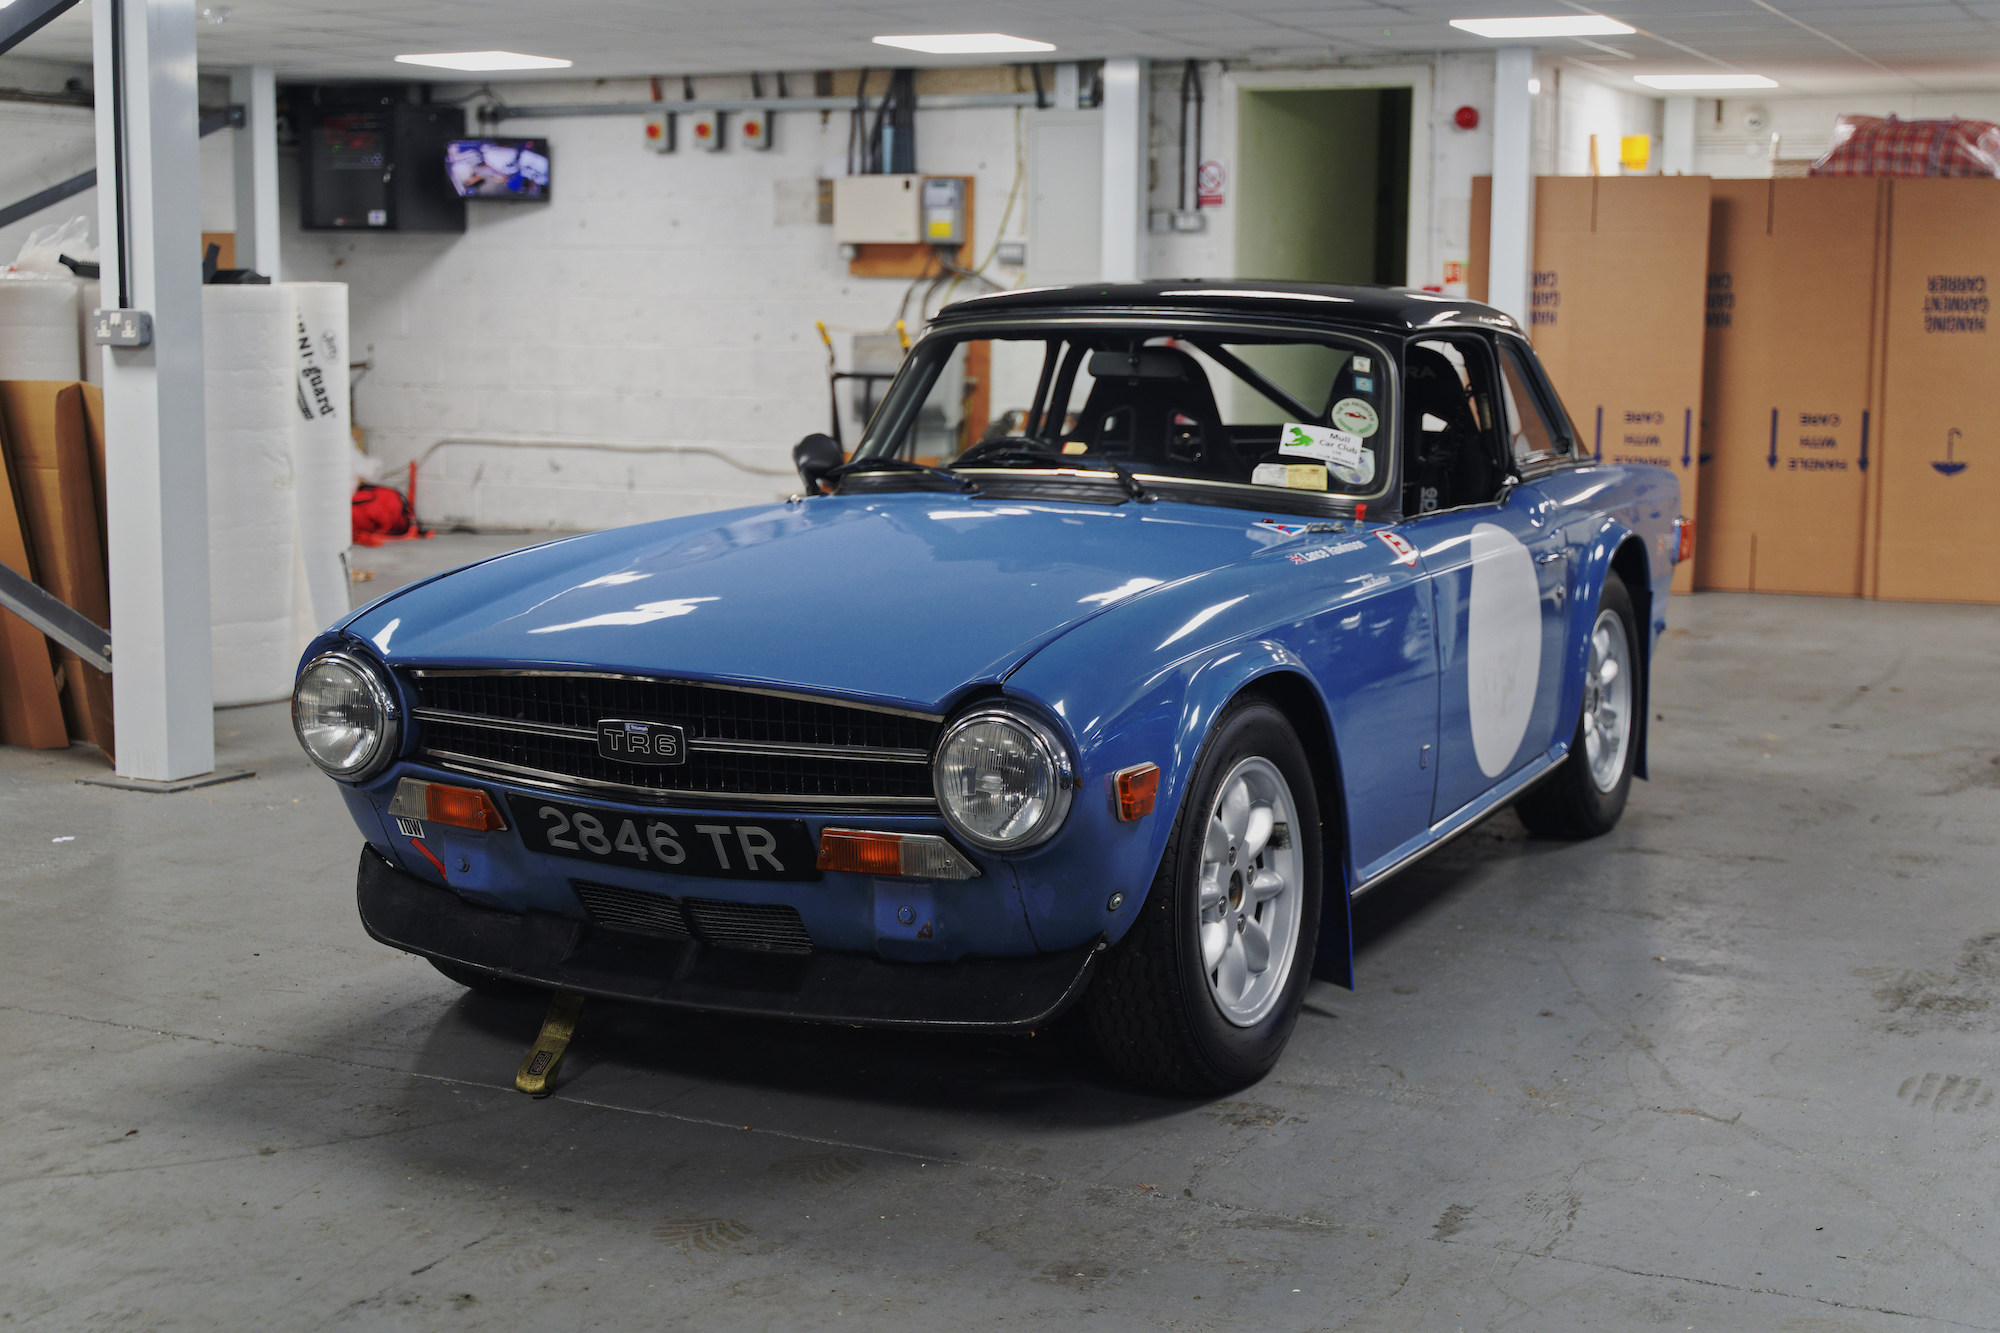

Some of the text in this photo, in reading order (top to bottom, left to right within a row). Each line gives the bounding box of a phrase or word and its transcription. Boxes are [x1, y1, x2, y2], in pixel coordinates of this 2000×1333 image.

[1927, 274, 1986, 294] CARRIER
[1923, 295, 1989, 314] GARMENT
[1924, 315, 1986, 334] HANGING
[1624, 411, 1664, 424] CARE
[1800, 413, 1841, 426] CARE
[1330, 433, 1350, 443] Mull
[1624, 435, 1661, 447] WITH
[1800, 437, 1838, 449] WITH
[1319, 439, 1357, 454] Car Club
[1788, 457, 1848, 471] HANDLE
[604, 728, 677, 756] TR6
[397, 818, 422, 836] TOW
[538, 806, 785, 872] 2846 TR
